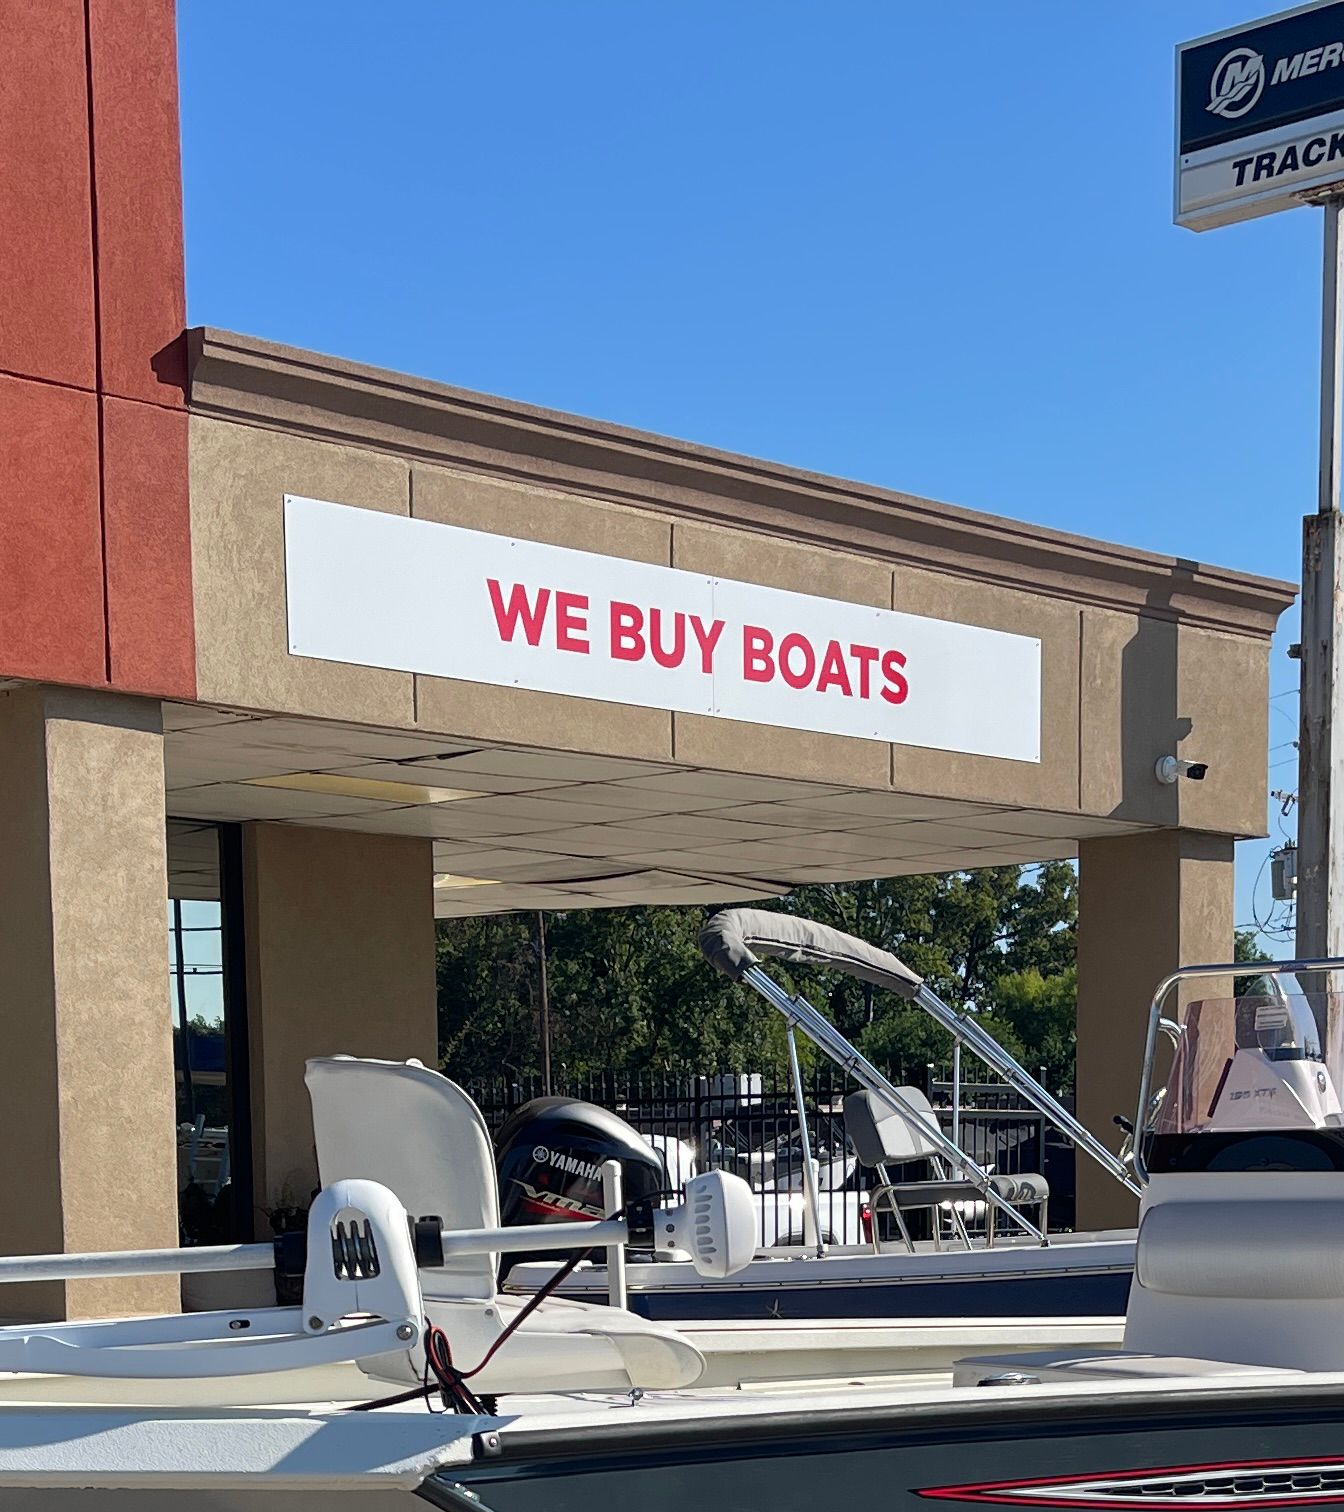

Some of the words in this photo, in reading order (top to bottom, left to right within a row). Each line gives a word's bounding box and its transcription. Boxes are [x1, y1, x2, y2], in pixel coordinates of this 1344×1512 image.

[486, 578, 590, 655] WE
[609, 601, 725, 675] BUY
[742, 626, 910, 705] BOATS
[549, 1150, 603, 1182] YAMAHA
